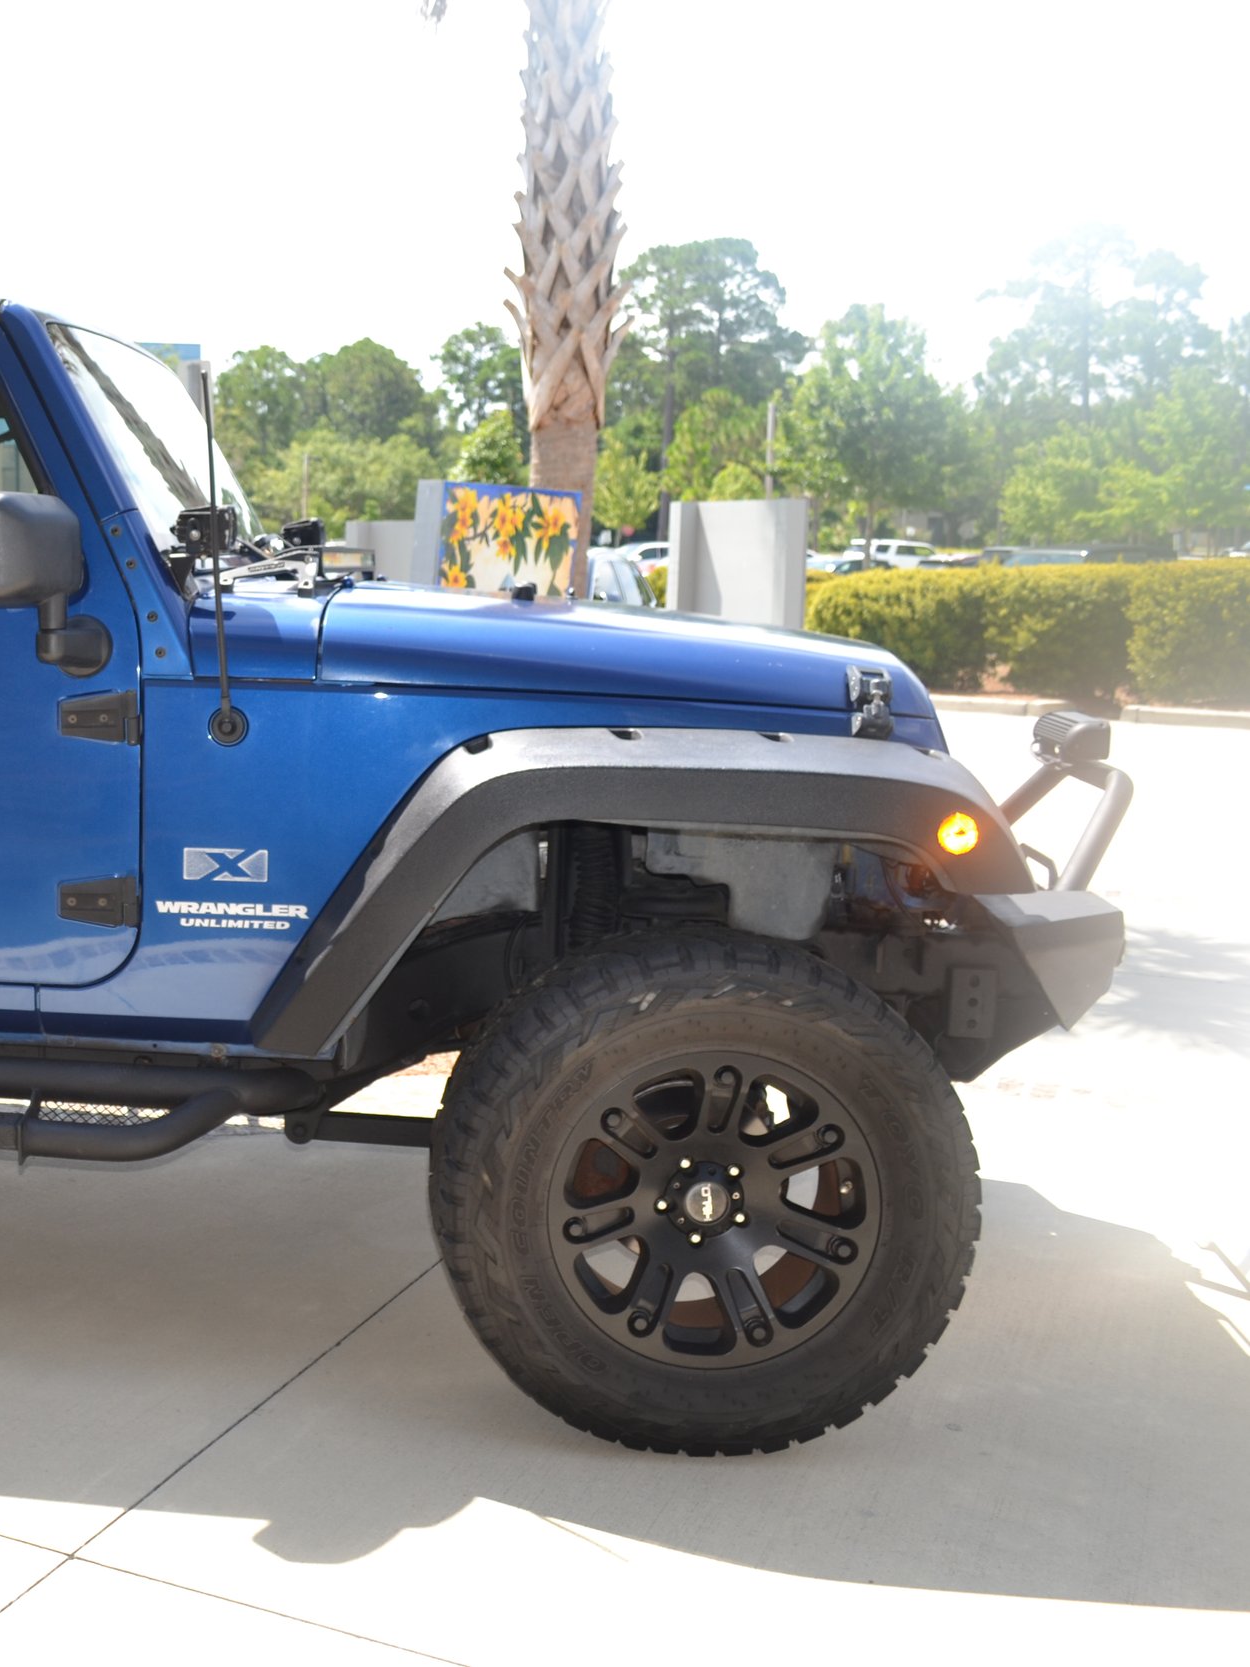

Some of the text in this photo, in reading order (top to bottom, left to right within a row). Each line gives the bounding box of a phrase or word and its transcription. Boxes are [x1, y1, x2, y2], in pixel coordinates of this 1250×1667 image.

[196, 848, 260, 882] X
[155, 900, 309, 919] WRANGLER
[180, 918, 290, 930] UNLIMITED
[858, 1071, 925, 1220] TOYO
[509, 1056, 609, 1375] OPEN COUNTRY
